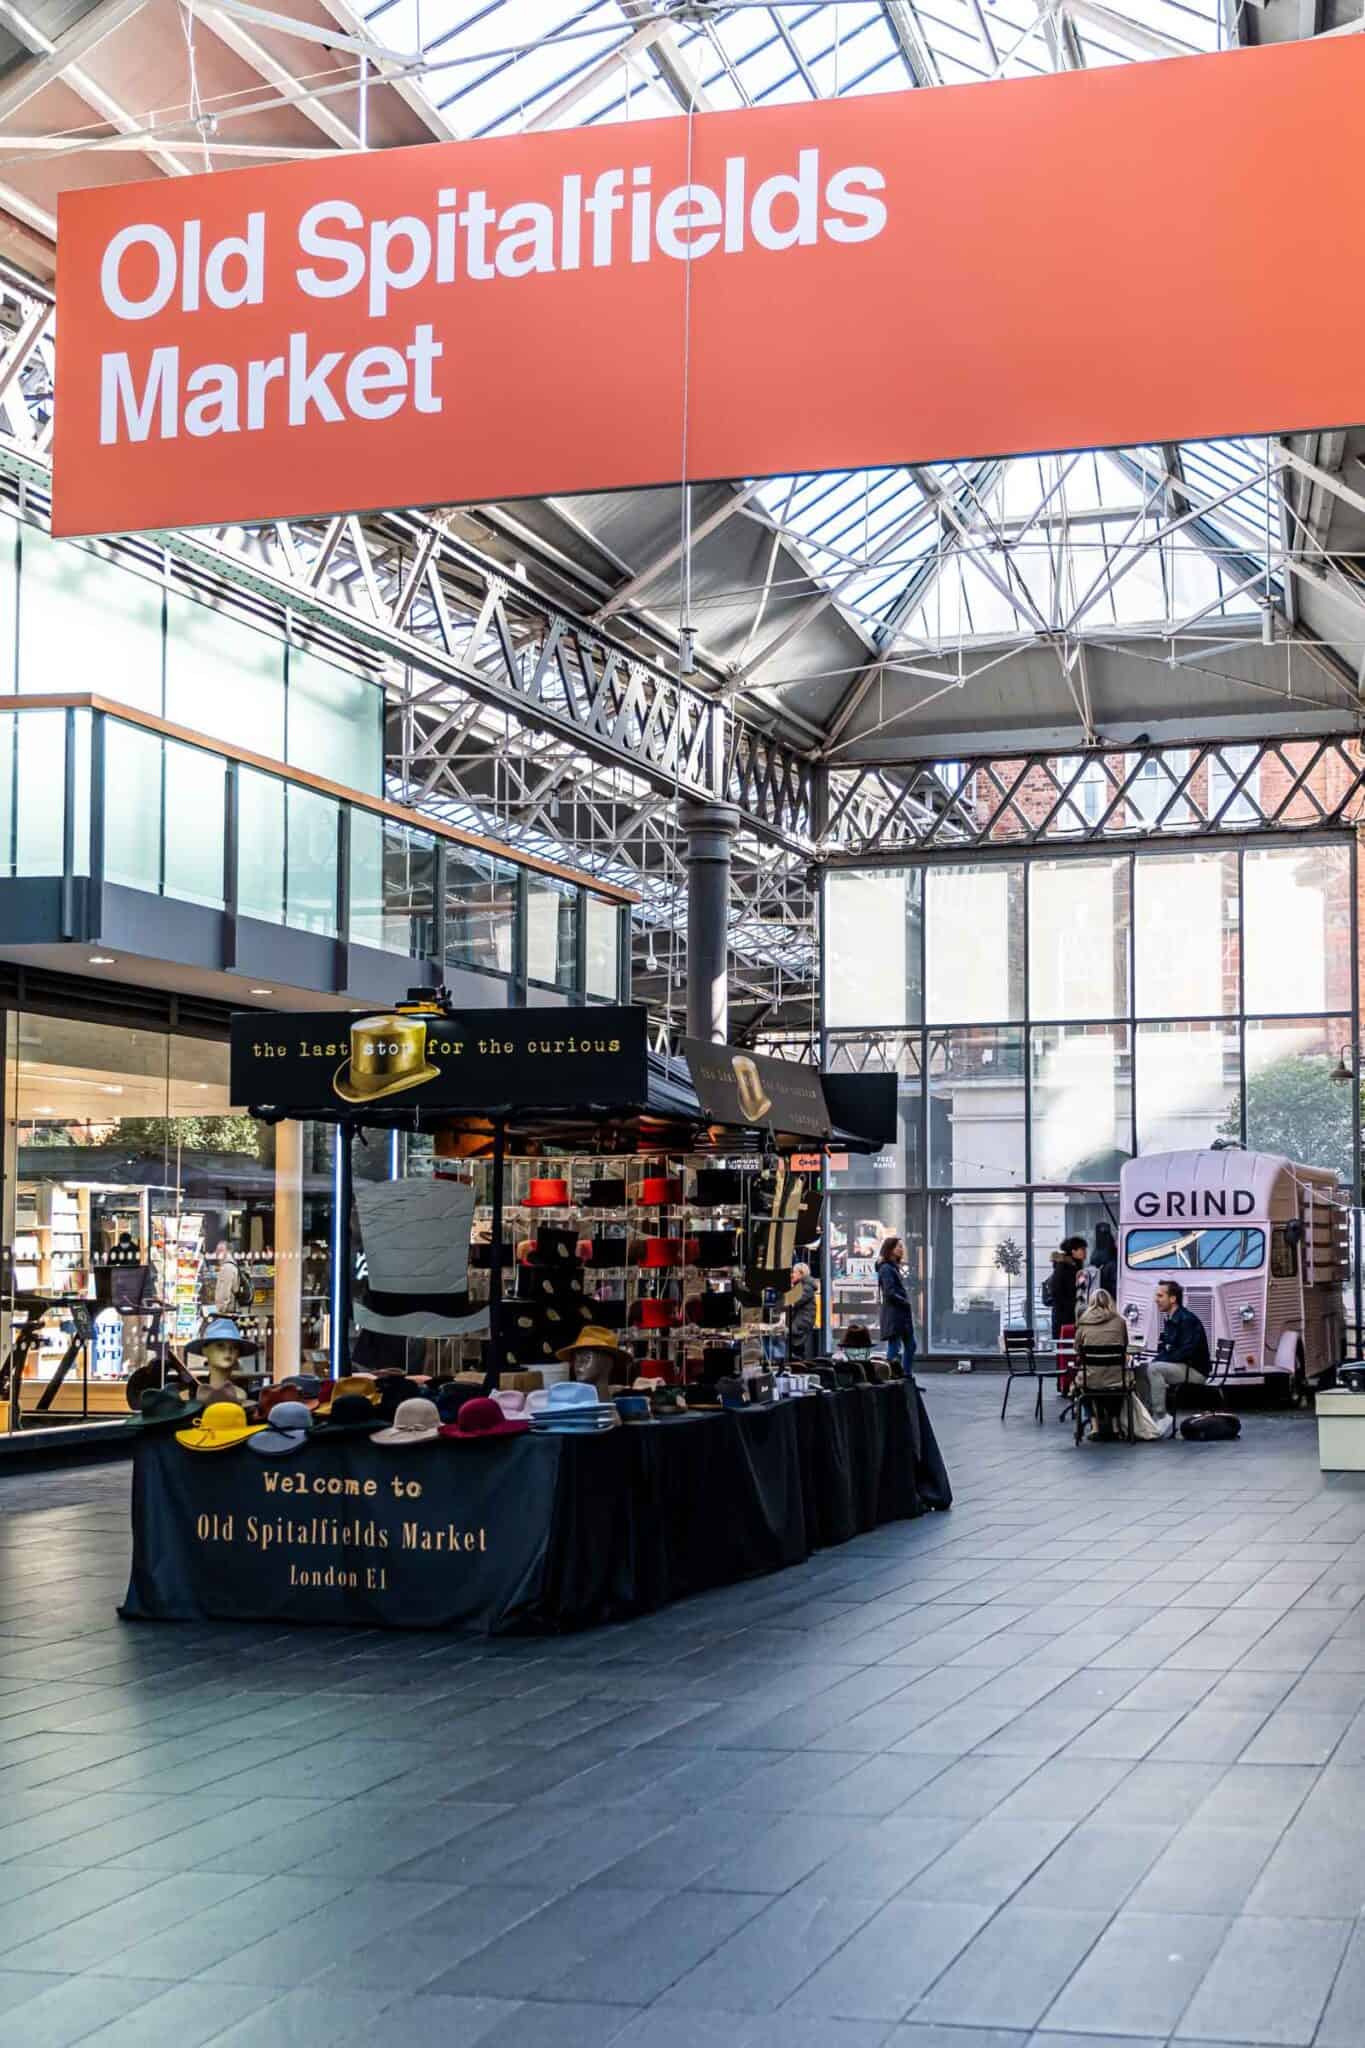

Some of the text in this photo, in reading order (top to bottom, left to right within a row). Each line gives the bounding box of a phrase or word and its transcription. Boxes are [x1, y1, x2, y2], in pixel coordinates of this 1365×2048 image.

[101, 149, 887, 320] Old Spitalfields
[100, 324, 443, 445] Market
[253, 1037, 620, 1059] the last stop for the curious
[1134, 1190, 1255, 1218] GRIND
[263, 1471, 421, 1498] Welcome to
[198, 1515, 487, 1551] Old Spitalfields Market
[290, 1565, 386, 1589] London E1
